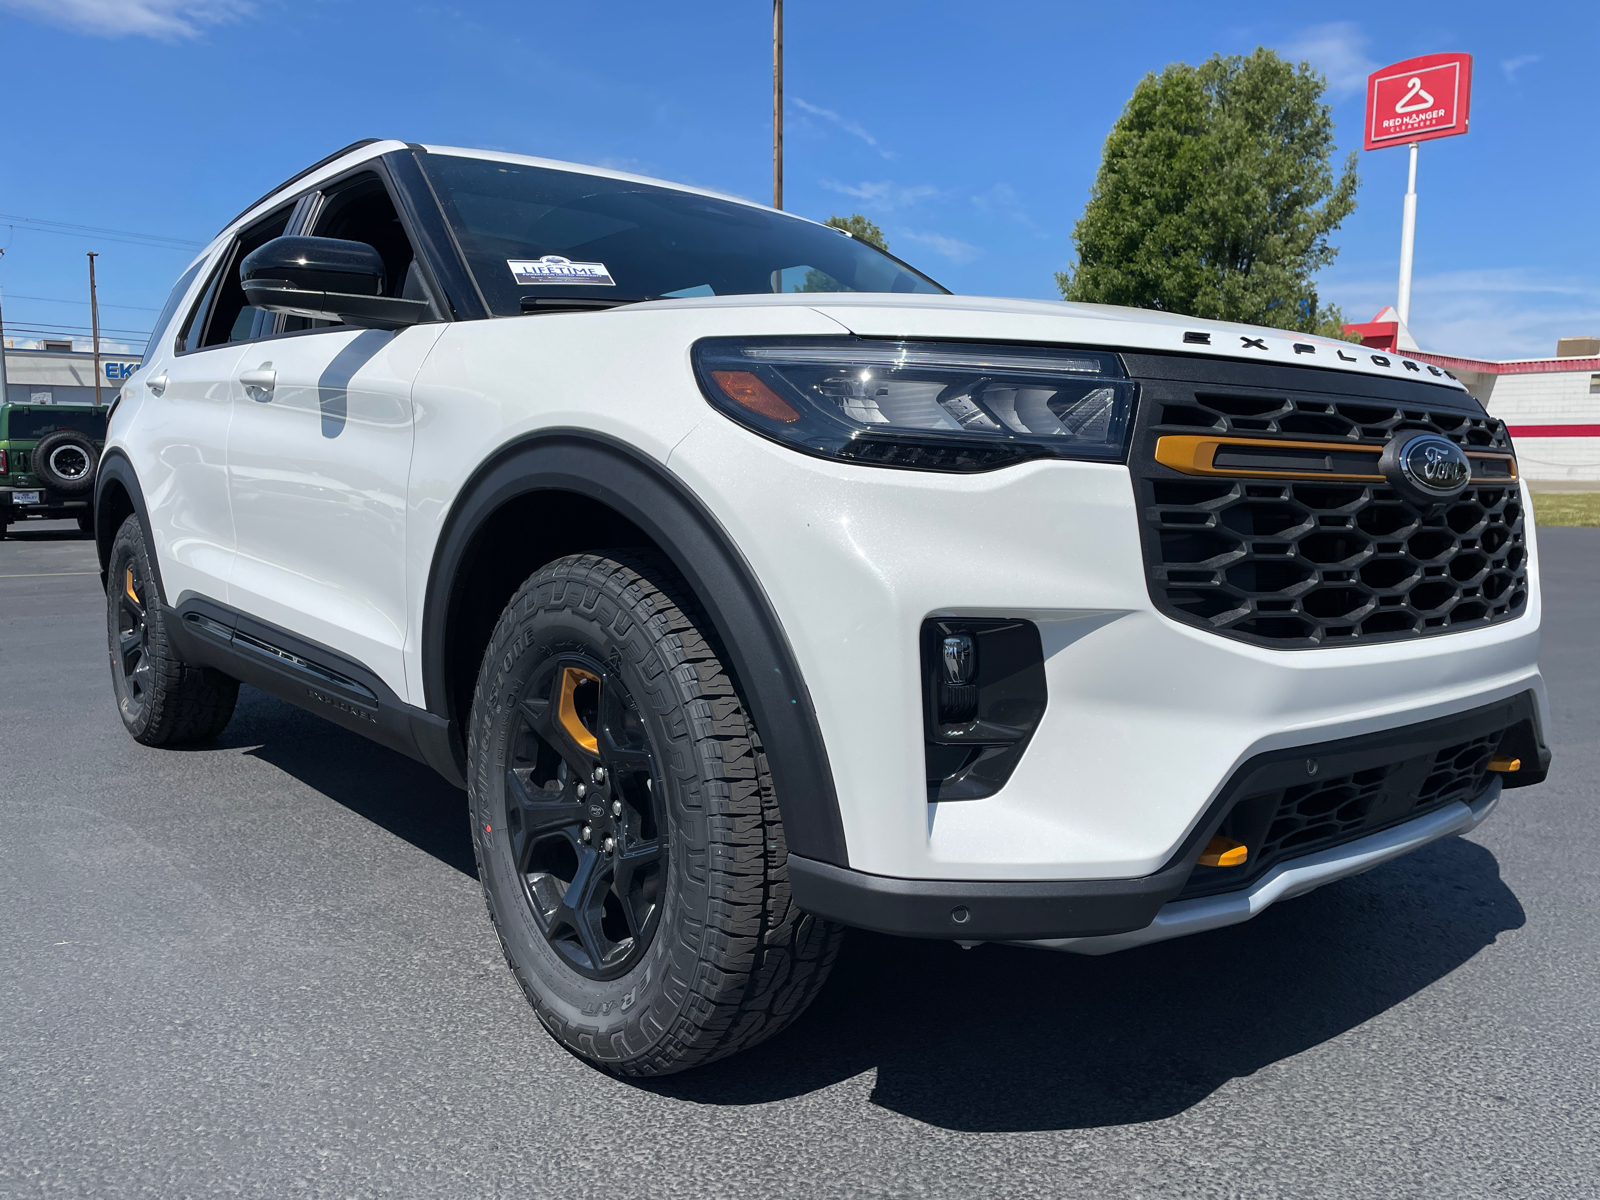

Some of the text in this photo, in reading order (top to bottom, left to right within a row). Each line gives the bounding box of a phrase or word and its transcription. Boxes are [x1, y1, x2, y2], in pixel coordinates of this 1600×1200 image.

[1383, 118, 1402, 128] RED
[1390, 119, 1436, 133] CLEANERS
[522, 266, 598, 275] LIFETIME
[105, 362, 141, 379] EK
[1423, 446, 1464, 481] Ford
[306, 688, 378, 725] EXPLORER
